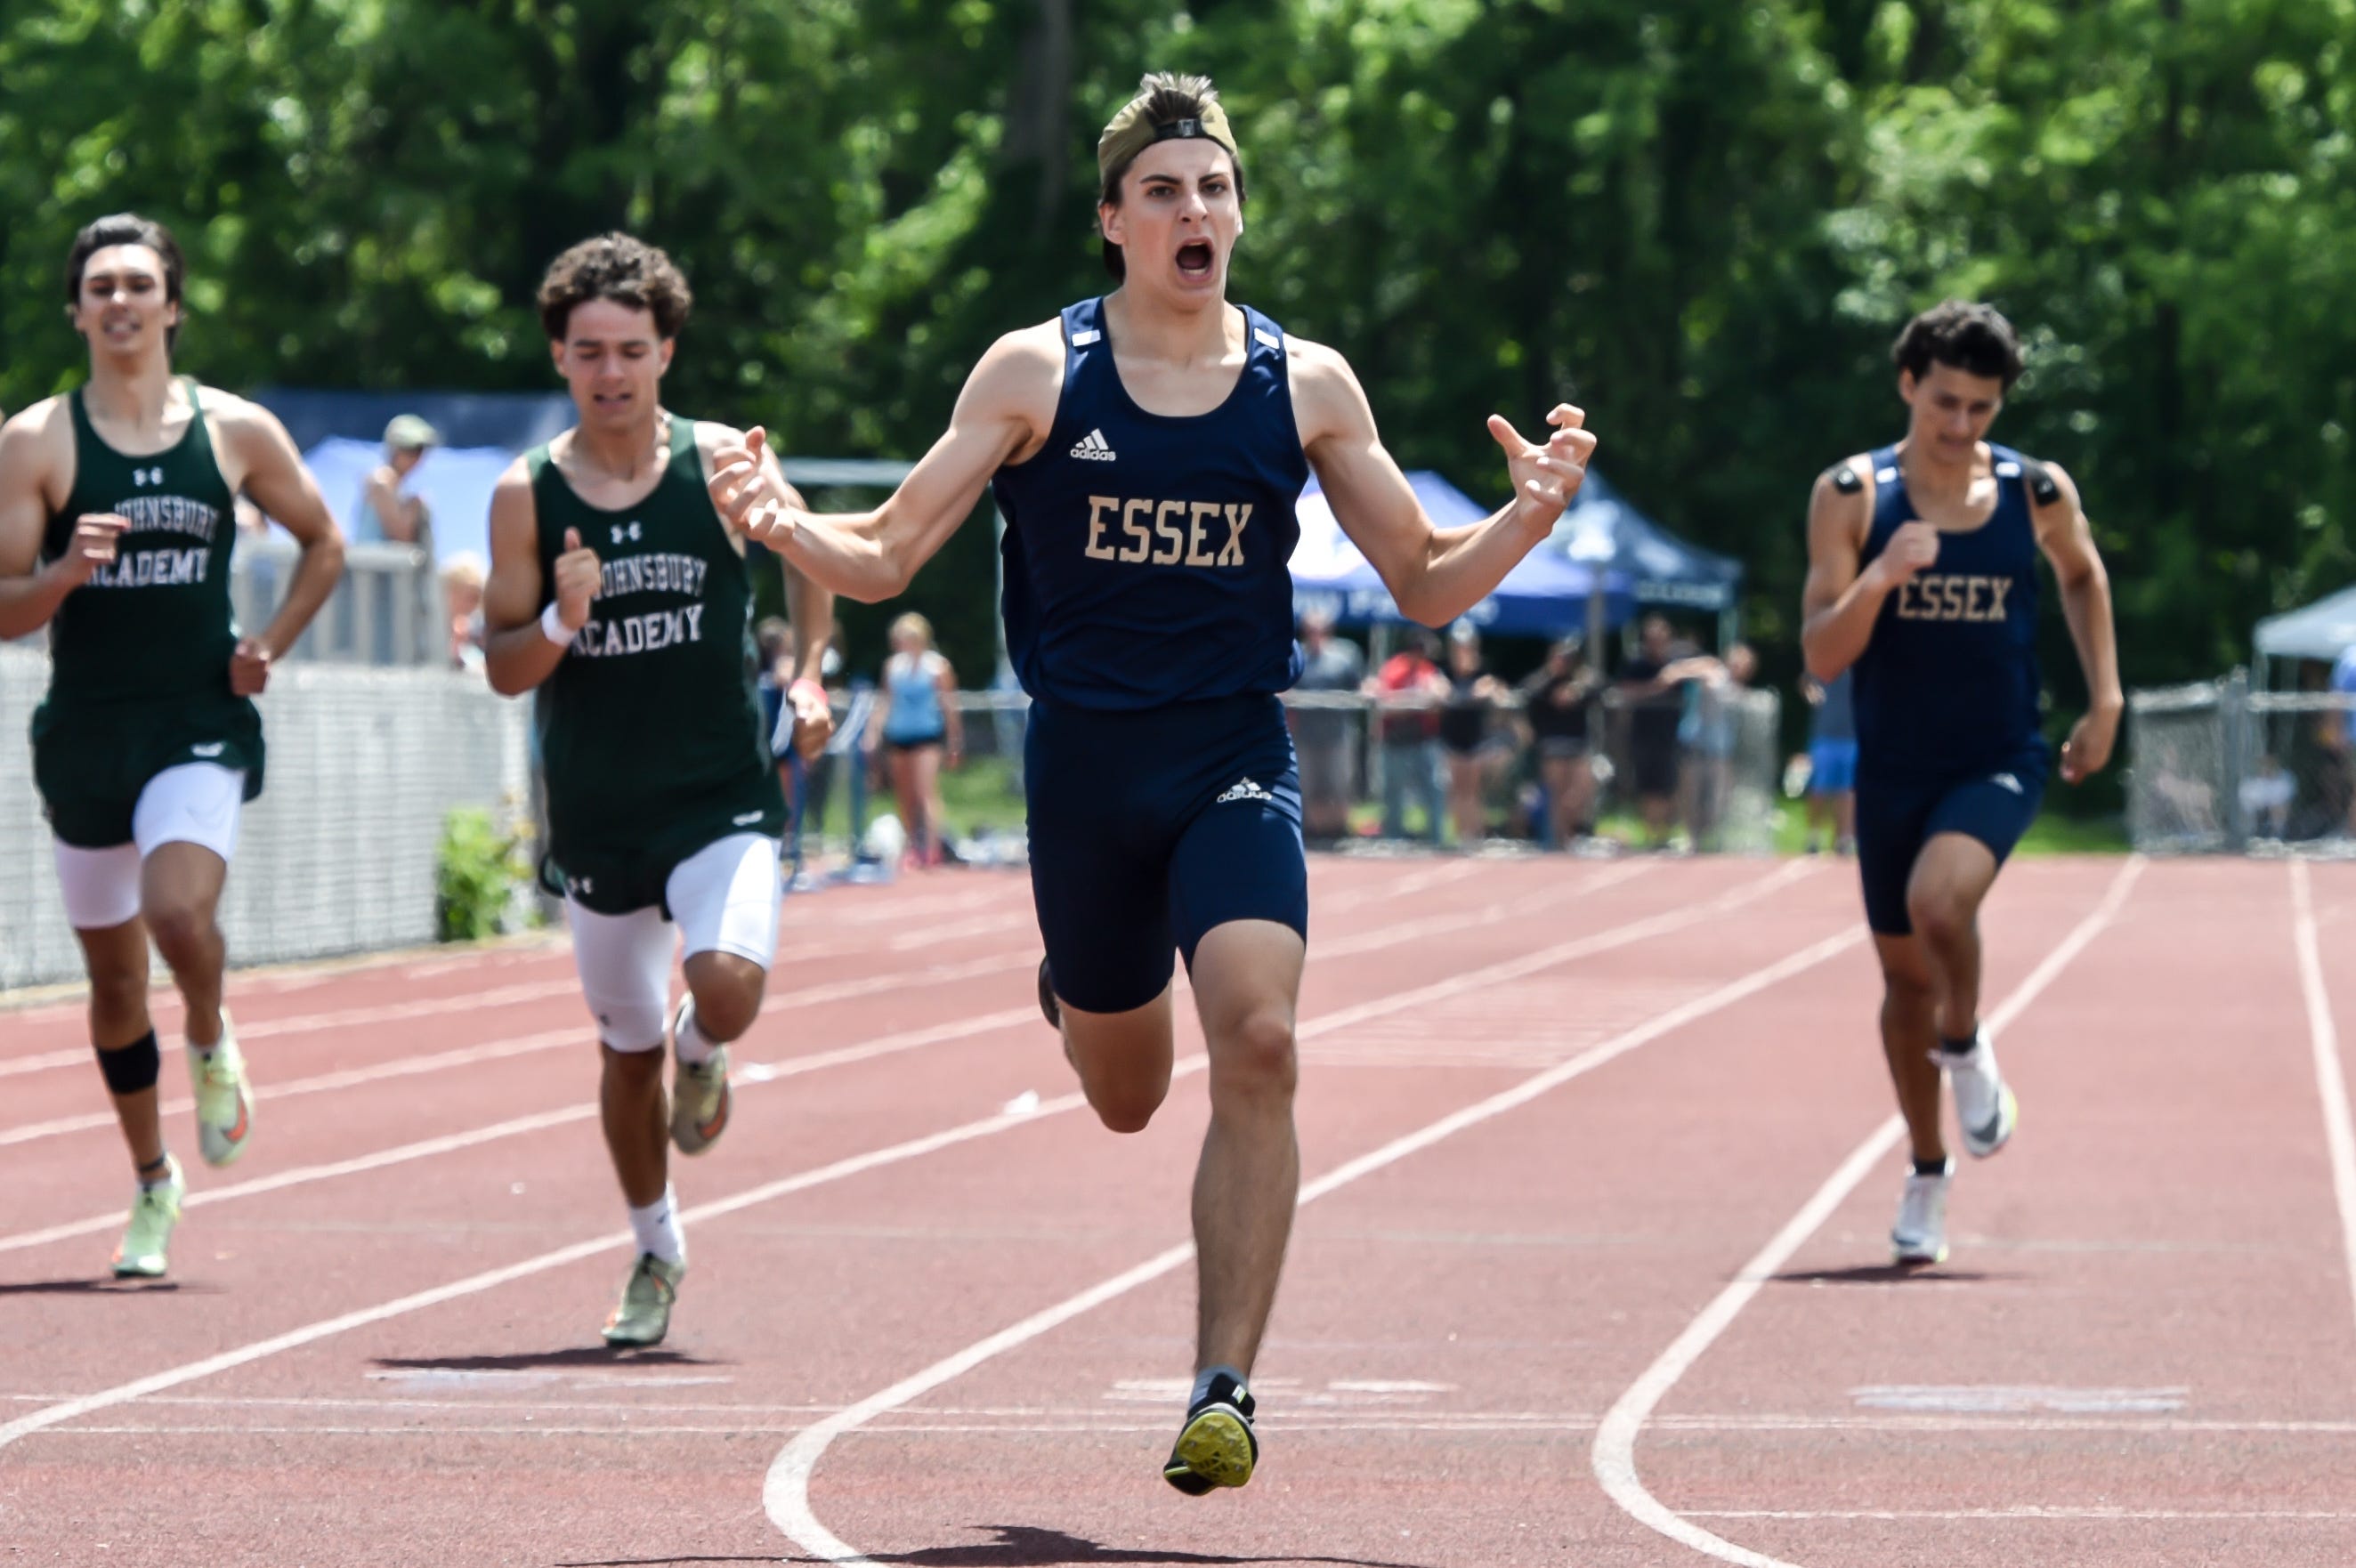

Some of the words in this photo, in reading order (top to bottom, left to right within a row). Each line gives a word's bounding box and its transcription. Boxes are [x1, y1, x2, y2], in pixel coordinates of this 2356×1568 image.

[1070, 448, 1116, 461] adidas
[114, 496, 219, 544] OHNSBURY
[1084, 496, 1253, 566] ESSEX
[594, 553, 708, 600] OHNSBURY
[1898, 574, 2012, 621] ESSEX
